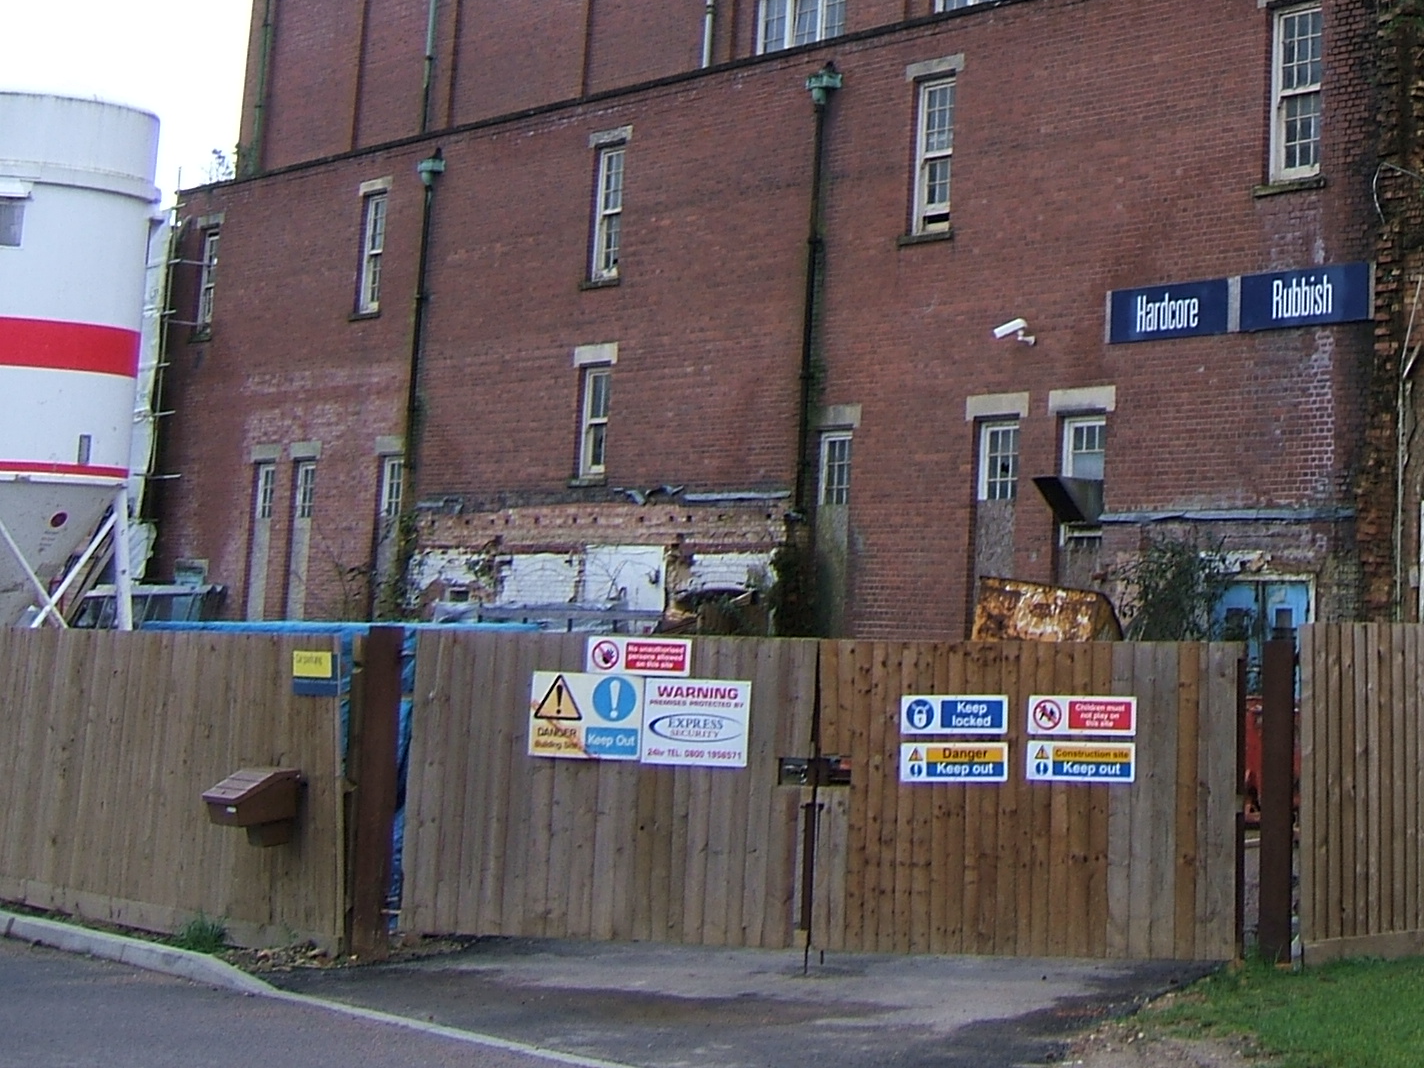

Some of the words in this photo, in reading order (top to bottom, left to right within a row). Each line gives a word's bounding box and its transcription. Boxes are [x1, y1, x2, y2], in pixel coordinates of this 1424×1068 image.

[1272, 274, 1333, 319] Rubbish
[1136, 295, 1199, 333] Hardcore
[657, 686, 739, 700] WARNING
[649, 699, 687, 707] PREMISES
[689, 700, 731, 708] PROTECTED
[957, 701, 988, 716] Keep
[1075, 703, 1105, 712] Children
[668, 717, 724, 729] EXPRESS
[952, 715, 992, 727] locked
[537, 727, 577, 737] DANGER
[670, 729, 720, 738] SECURITY
[534, 740, 562, 750] Building
[587, 733, 613, 747] Keep
[616, 734, 635, 746] Out
[684, 749, 705, 758] 0800
[942, 748, 988, 761] Danger
[1055, 749, 1111, 759] Construction
[1113, 750, 1129, 759] site
[937, 762, 970, 775] Keep
[972, 763, 994, 774] out
[1063, 761, 1096, 776] Keep
[1099, 763, 1121, 775] out
